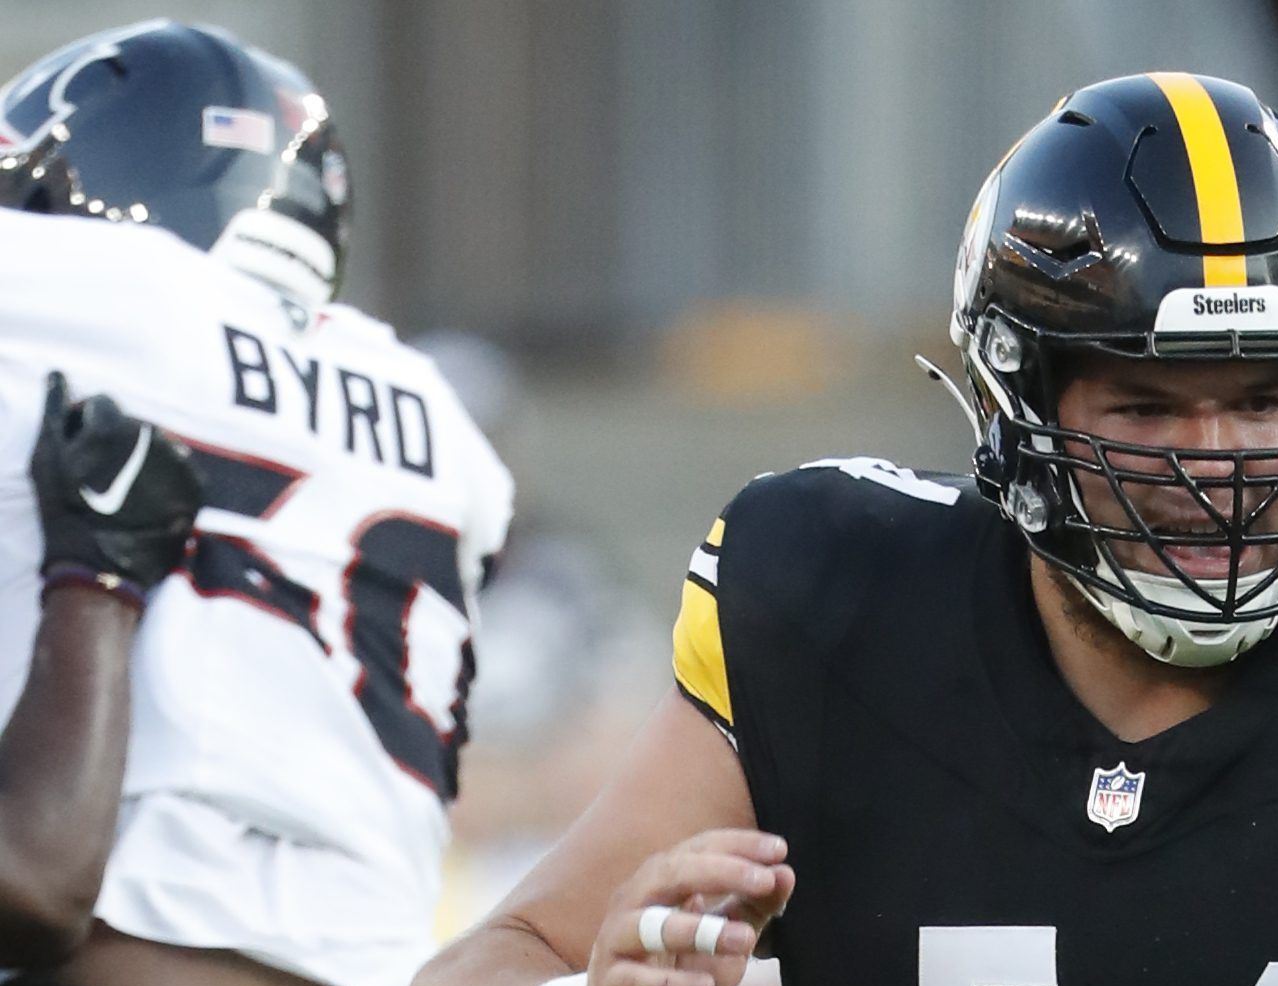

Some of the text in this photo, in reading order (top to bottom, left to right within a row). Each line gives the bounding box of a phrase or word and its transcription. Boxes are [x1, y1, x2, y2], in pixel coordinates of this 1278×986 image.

[1193, 292, 1266, 315] Steelers
[223, 324, 435, 480] BYRD
[1097, 792, 1130, 817] NFL
